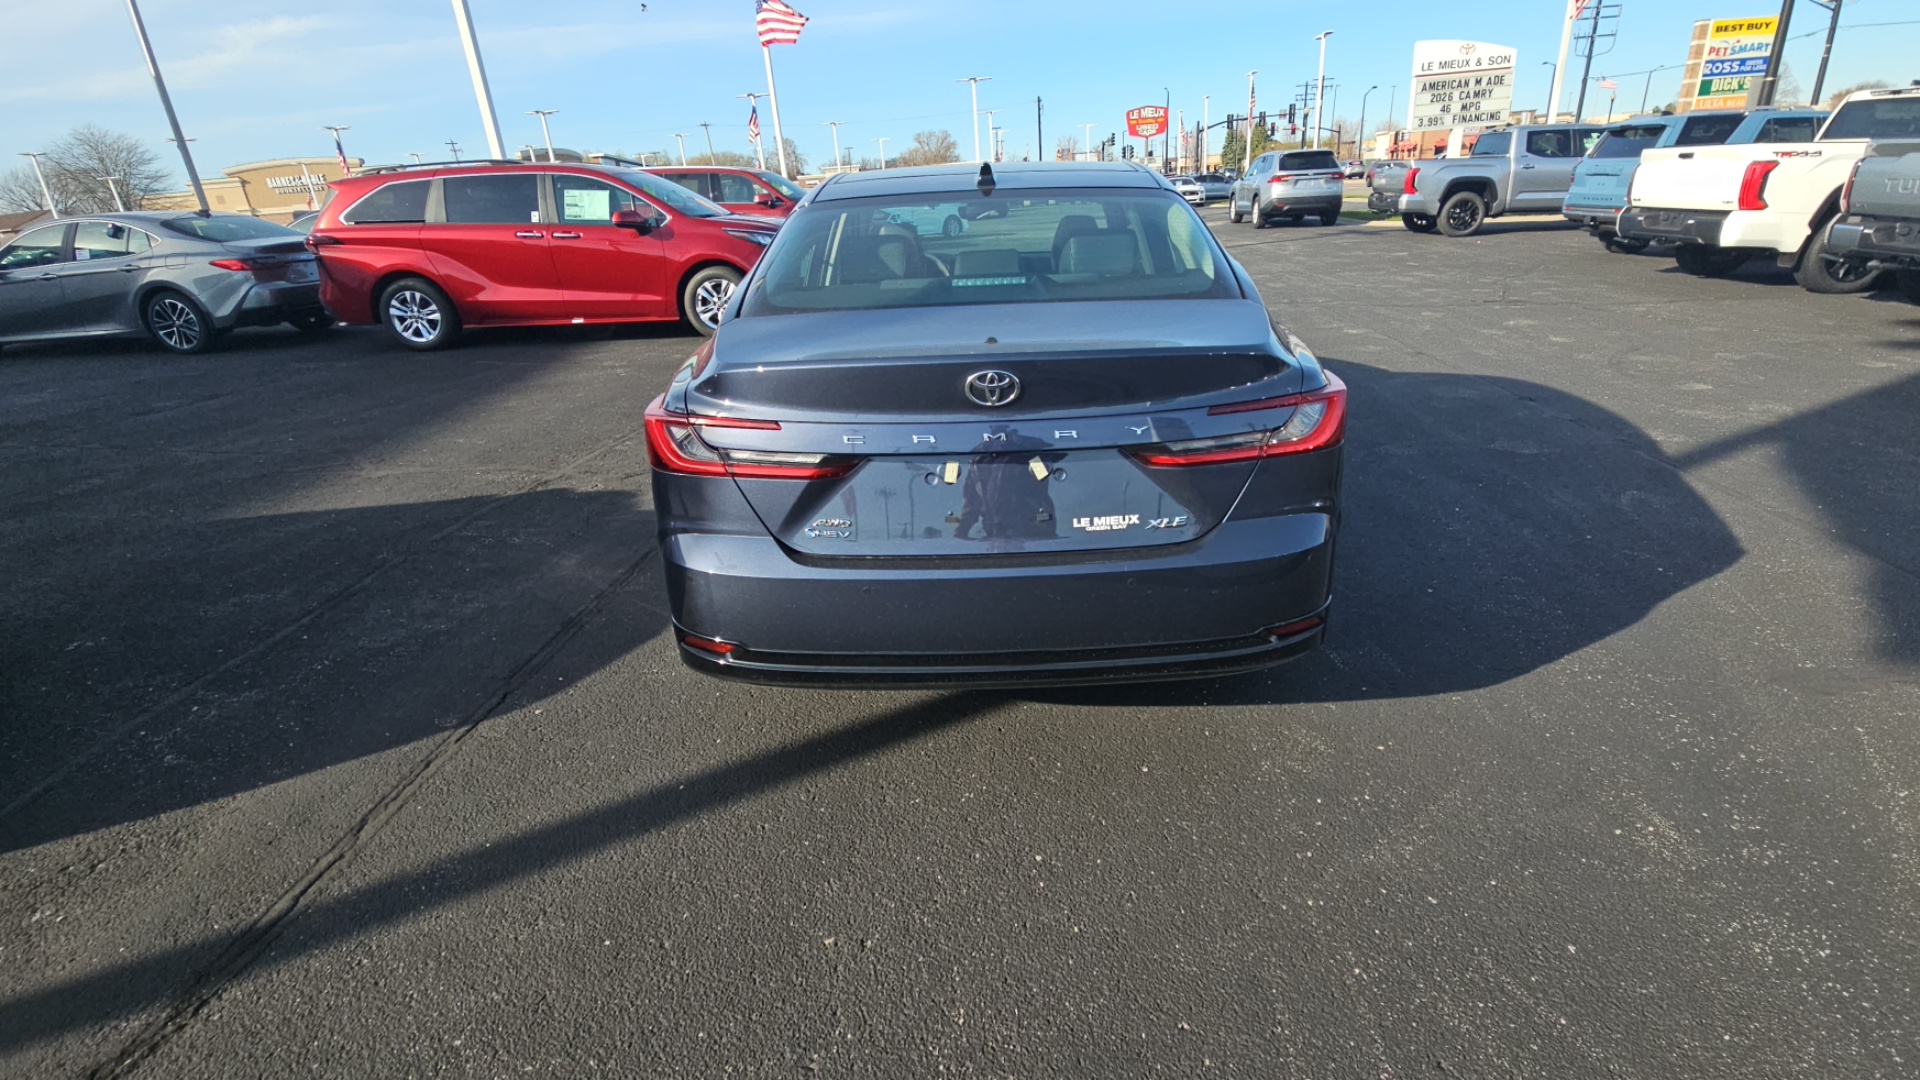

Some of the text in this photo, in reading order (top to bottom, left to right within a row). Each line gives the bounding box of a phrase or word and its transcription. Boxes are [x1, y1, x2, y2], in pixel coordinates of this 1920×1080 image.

[1715, 22, 1772, 33] BEST BUY
[1421, 54, 1511, 72] LE MIEUX & SON
[1702, 61, 1741, 75] ROSS
[1421, 78, 1470, 92] AMERICAN
[1710, 76, 1753, 92] DICK'S
[1430, 88, 1493, 103] 2026 CAMRY
[1440, 101, 1481, 113] 46 MPG
[1130, 110, 1139, 119] LE
[1418, 111, 1501, 128] 3.99% FINANCING
[842, 425, 1149, 445] CAMRY
[1073, 514, 1140, 528] LE MIEUX
[1145, 515, 1188, 530] XLE
